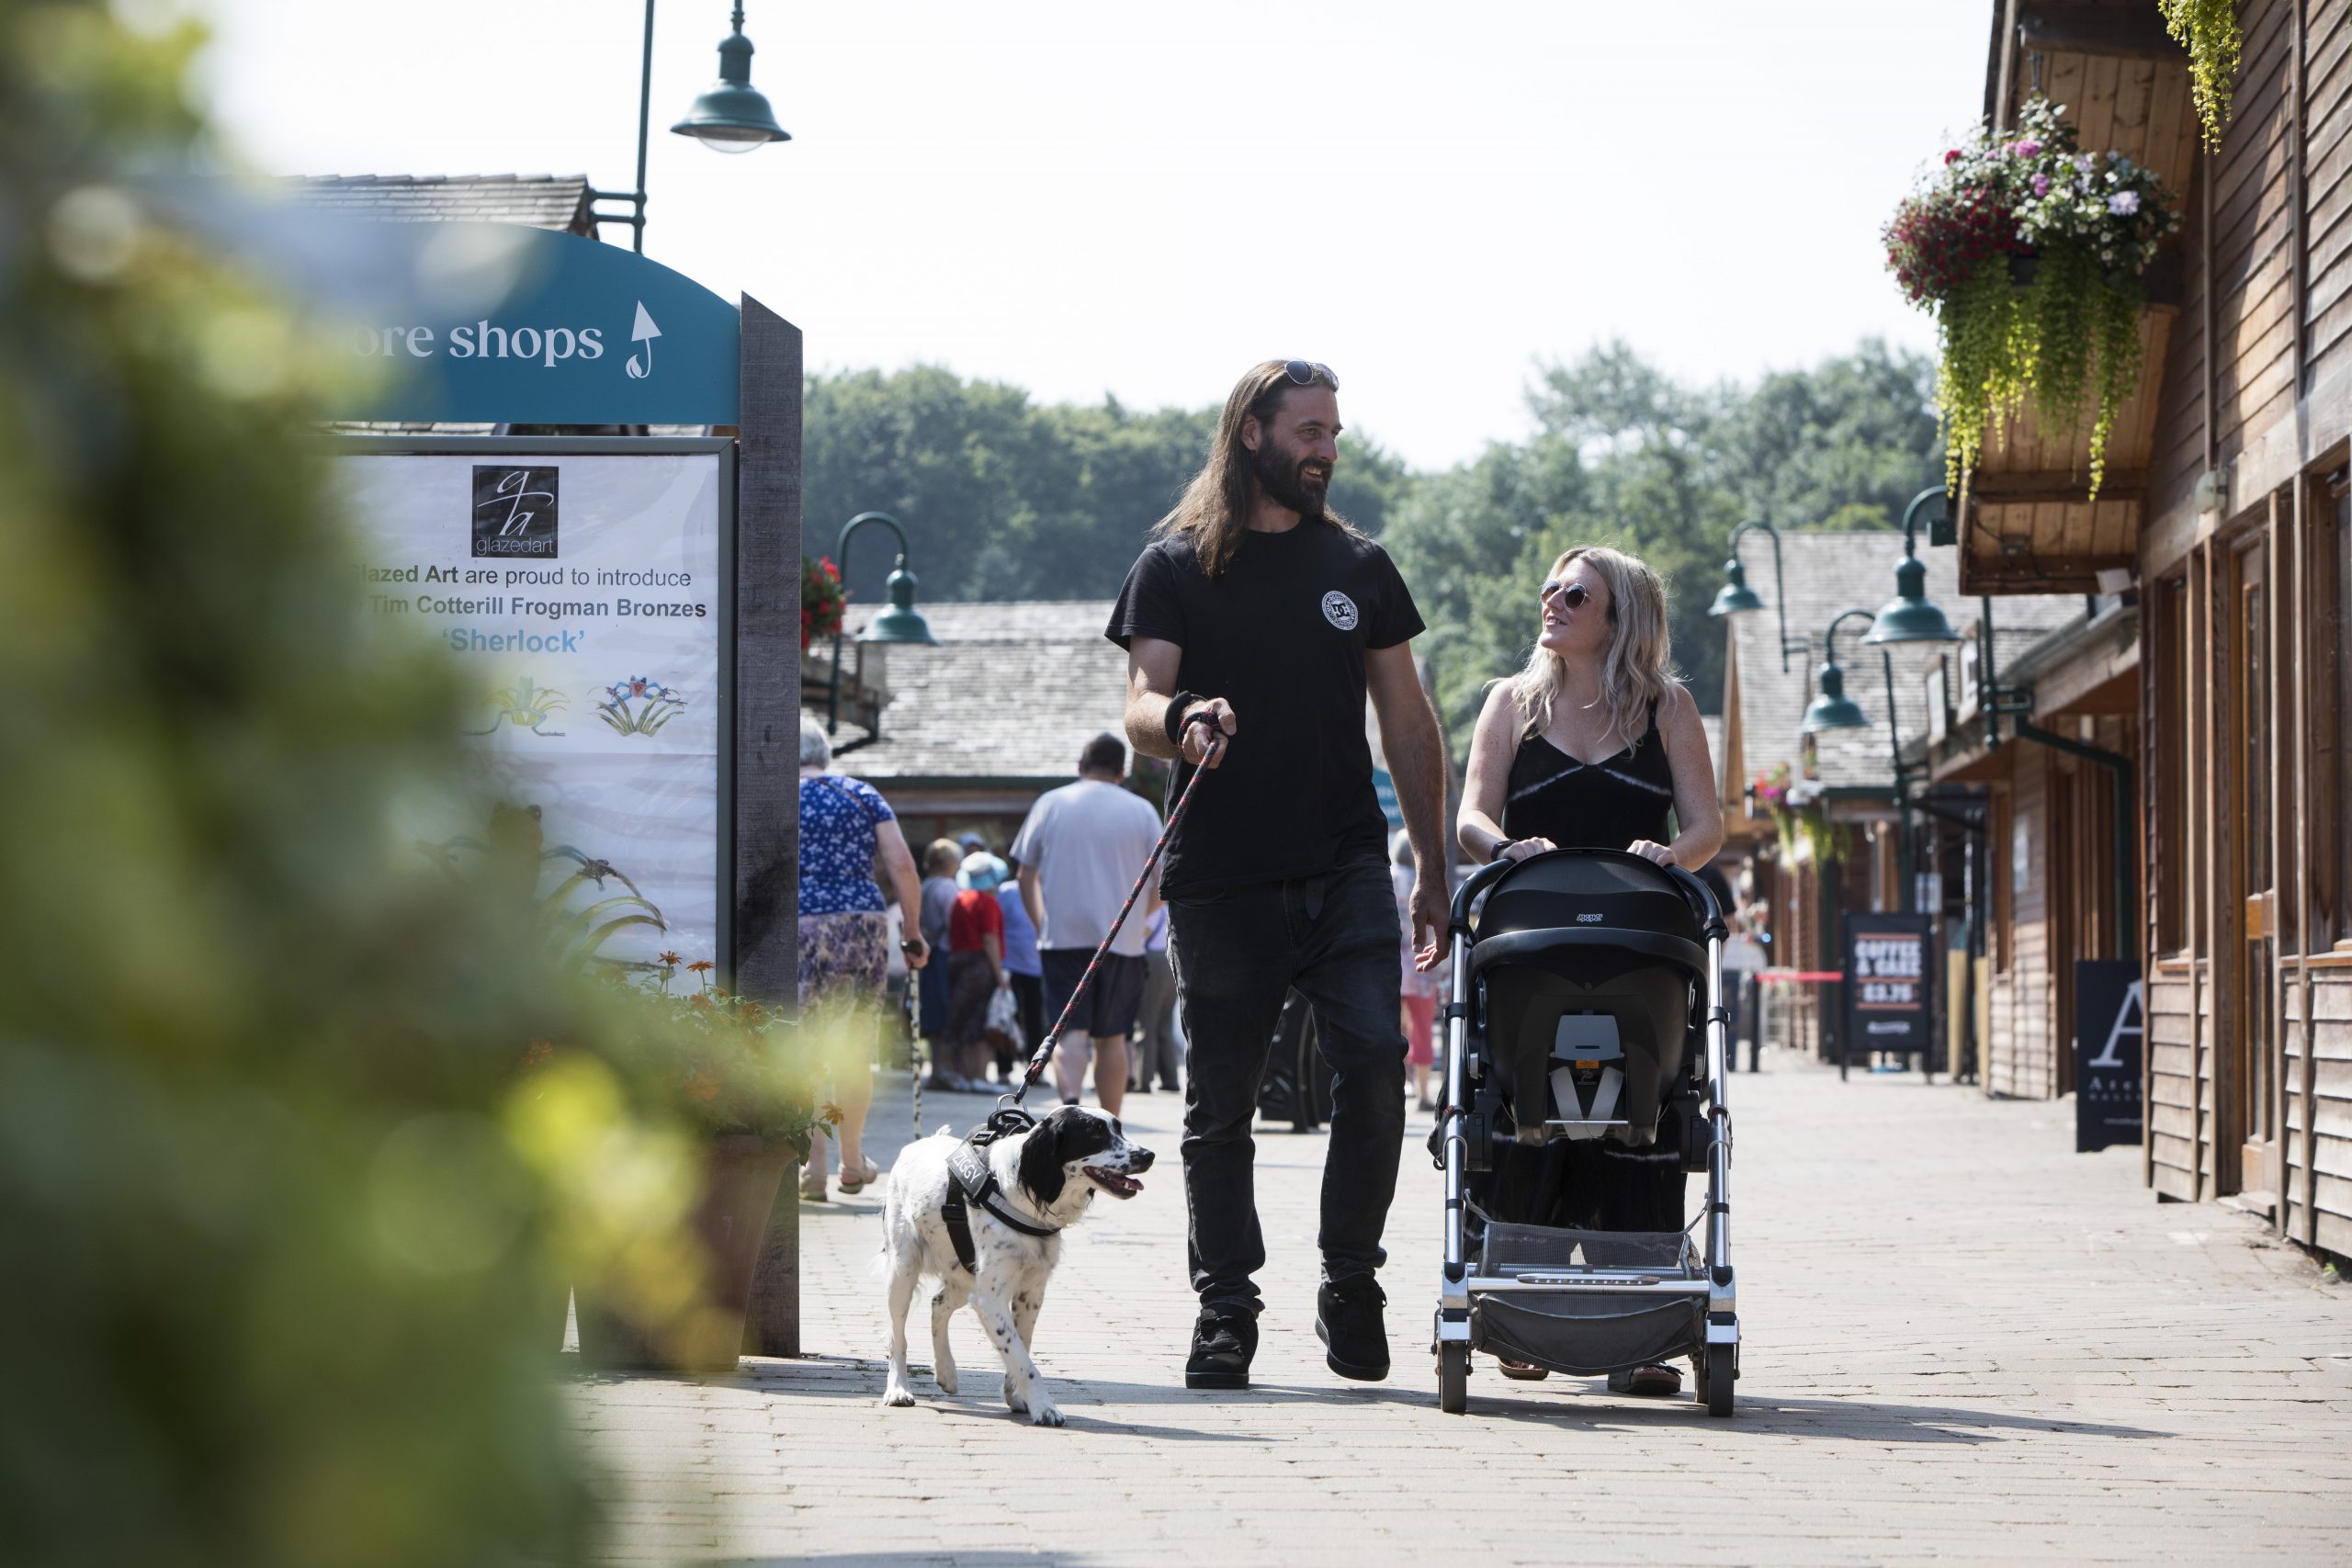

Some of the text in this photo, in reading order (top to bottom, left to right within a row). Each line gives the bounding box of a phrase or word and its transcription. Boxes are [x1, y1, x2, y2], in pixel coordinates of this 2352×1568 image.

[334, 320, 605, 368] ore shops
[476, 536, 554, 556] glazedart
[424, 565, 458, 583] Art
[465, 570, 498, 584] are
[505, 568, 563, 589] proud
[571, 569, 590, 585] to
[597, 568, 692, 587] introduce
[368, 595, 409, 614] Tim
[417, 595, 503, 615] Cotterill
[511, 596, 609, 620] Frogman
[616, 598, 707, 617] Bronzes
[952, 1150, 982, 1184] ZIGGY
